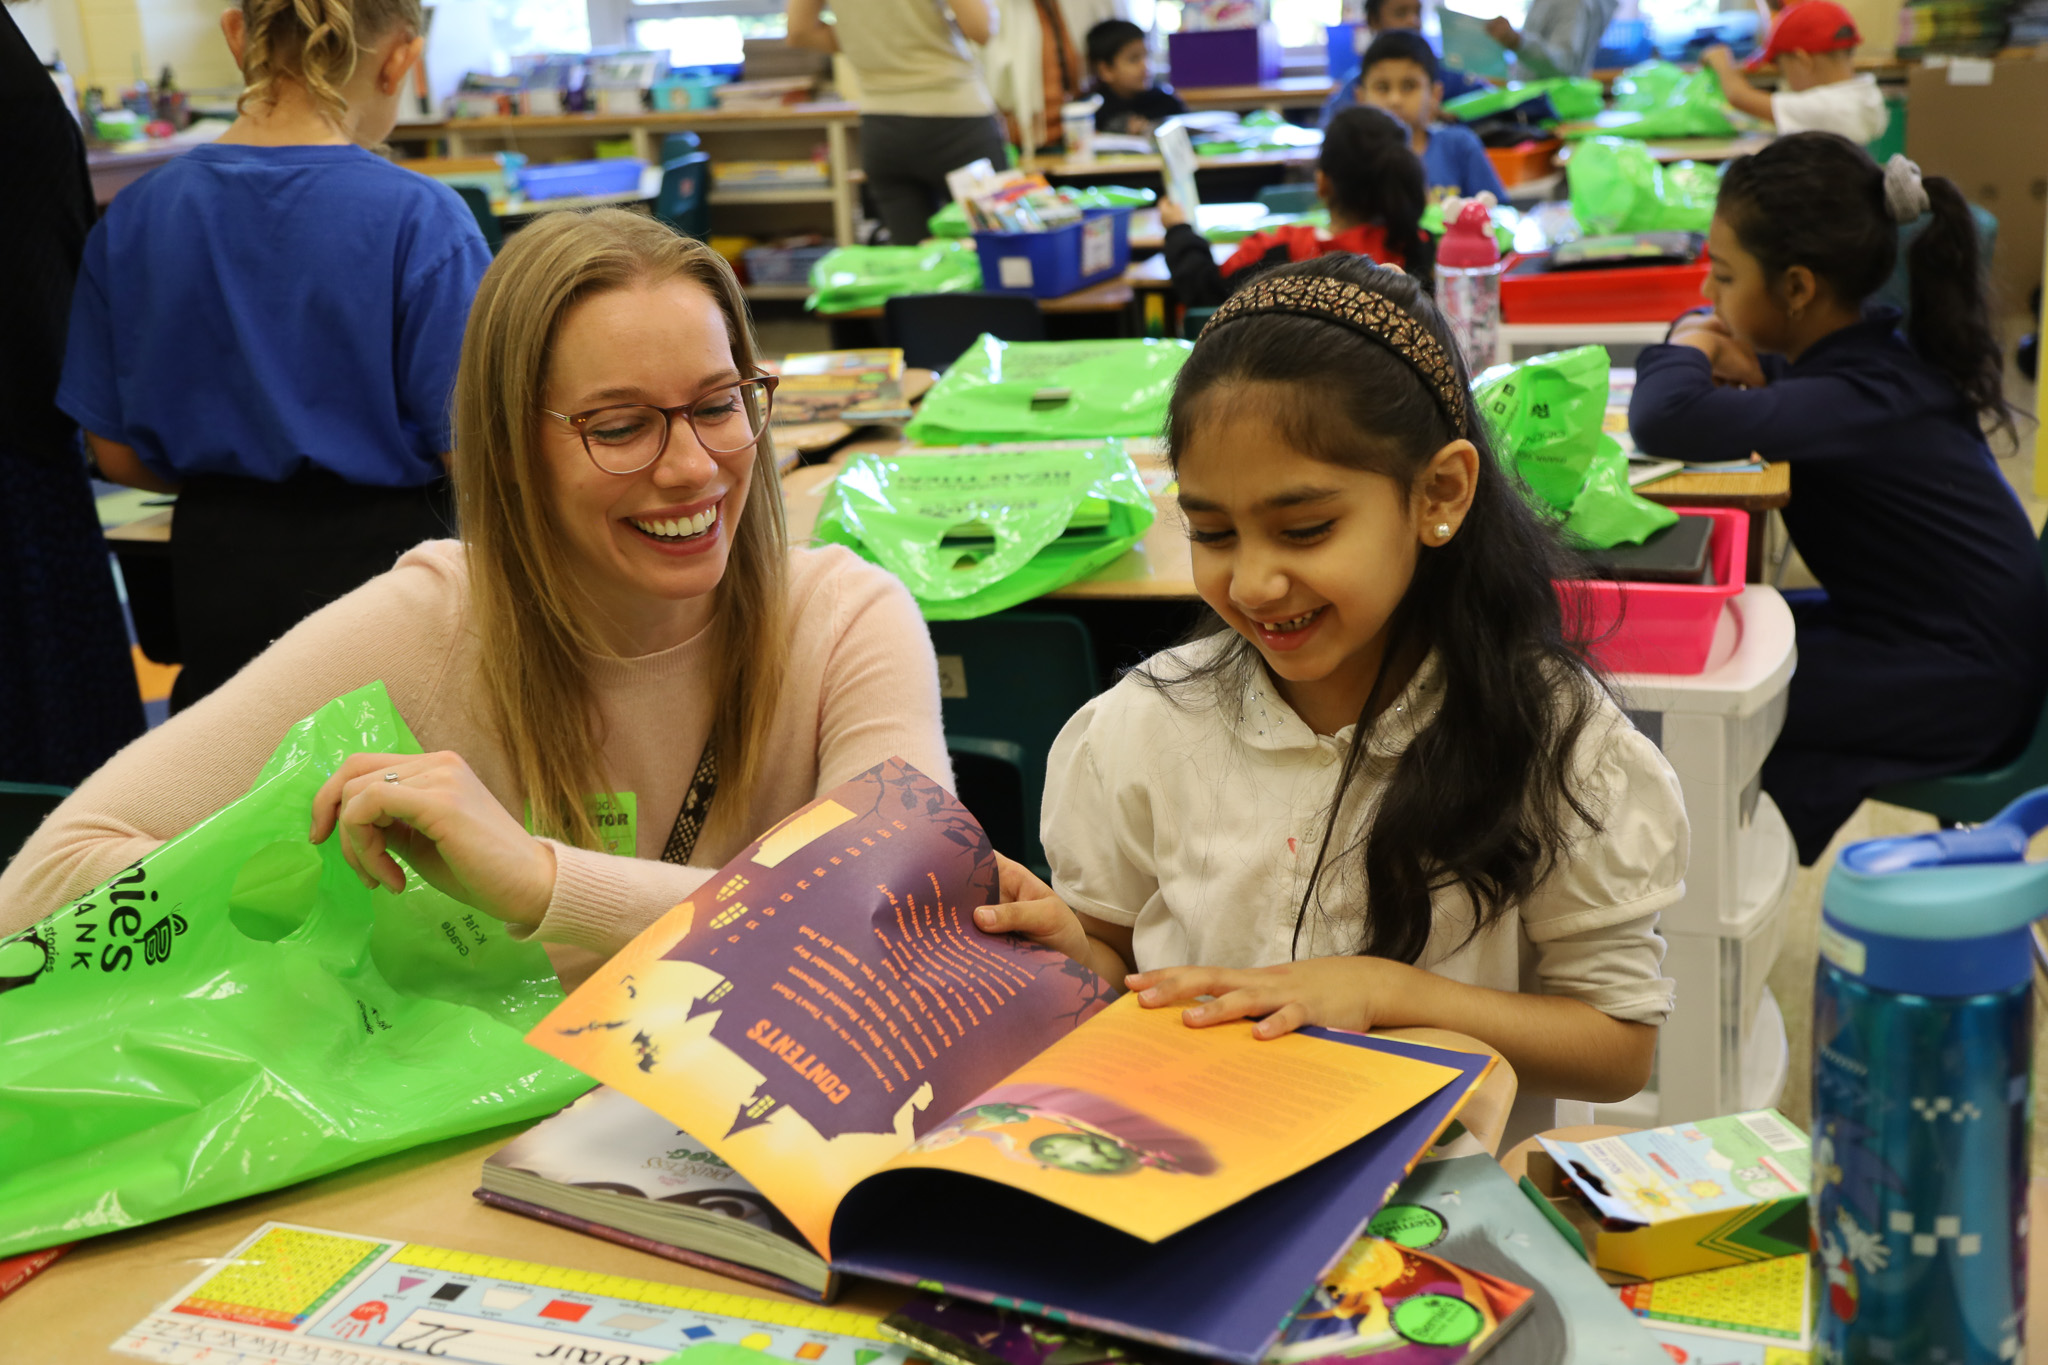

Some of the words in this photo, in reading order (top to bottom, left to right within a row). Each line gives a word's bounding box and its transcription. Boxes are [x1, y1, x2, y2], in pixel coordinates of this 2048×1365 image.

[892, 820, 907, 830] 173
[845, 847, 861, 856] 127
[813, 867, 826, 877] 95
[796, 880, 810, 890] 79
[779, 892, 794, 902] 63
[877, 884, 898, 905] Party
[927, 872, 946, 928] Holler-ween!
[762, 907, 776, 916] 47
[906, 894, 924, 938] Cinderella
[924, 905, 932, 926] Ever
[951, 906, 963, 934] Treats
[745, 920, 760, 930] 33
[799, 925, 820, 940] Pooh
[895, 907, 912, 942] Slumber
[728, 934, 740, 943] 17
[818, 936, 833, 948] the
[874, 928, 893, 950] Night
[929, 928, 942, 944] Day
[944, 929, 966, 951] Happy
[794, 944, 812, 960] Way
[922, 940, 934, 951] for
[832, 944, 859, 966] Winnie
[934, 951, 968, 974] Costume
[881, 958, 901, 980] Treat
[913, 961, 925, 972] for
[788, 966, 828, 995] Halloween
[876, 979, 887, 991] to
[902, 981, 912, 990] or
[926, 971, 947, 988] Trick
[772, 982, 797, 1000] Ghost
[853, 988, 866, 998] of
[886, 990, 900, 1006] Boo
[947, 986, 955, 994] A
[795, 996, 824, 1019] Tiana's
[824, 991, 860, 1022] Haunted
[864, 996, 887, 1021] Witch
[909, 989, 928, 1013] Trick
[858, 1019, 884, 1048] Riley's
[886, 1020, 900, 1038] The
[912, 1022, 923, 1034] the
[921, 1034, 938, 1058] Winnie
[746, 1019, 851, 1104] CONTENTS
[882, 1079, 895, 1093] The
[398, 1321, 474, 1357] 22
